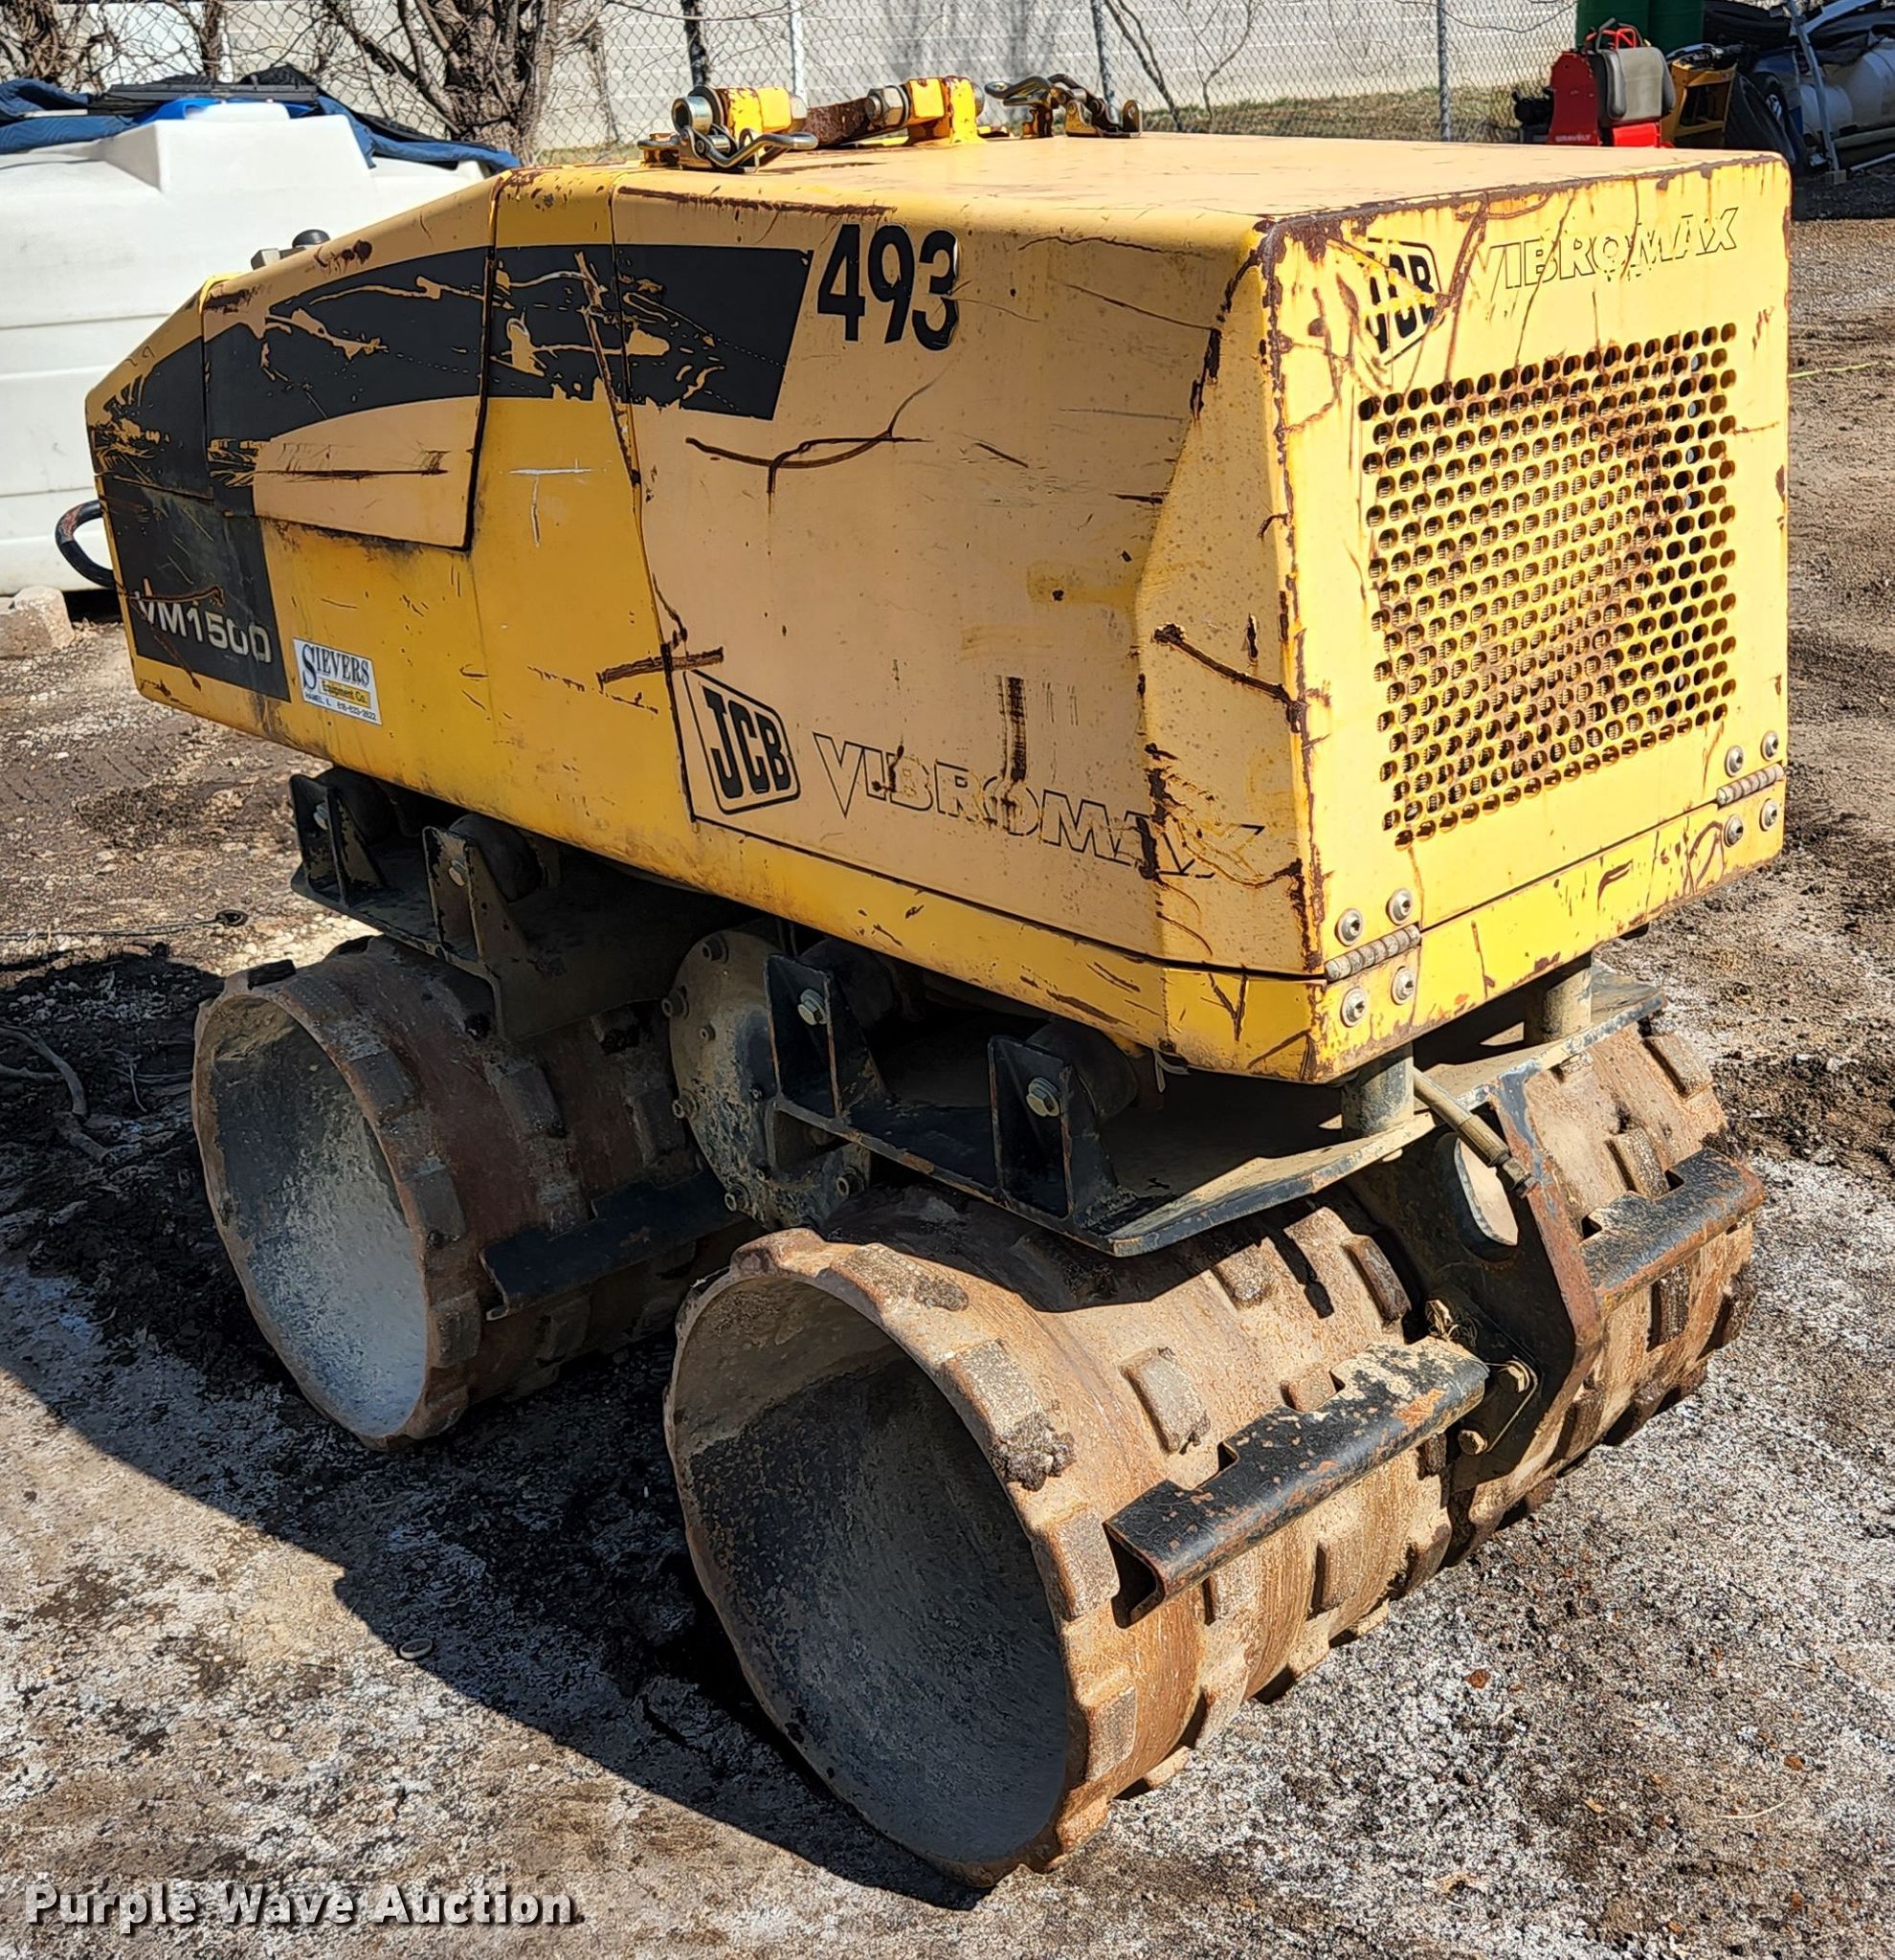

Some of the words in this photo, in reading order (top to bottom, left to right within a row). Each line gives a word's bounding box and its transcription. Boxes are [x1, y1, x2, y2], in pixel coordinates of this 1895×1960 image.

[817, 224, 958, 351] 493
[302, 644, 369, 690] SIEVERS
[705, 686, 793, 800] JCB
